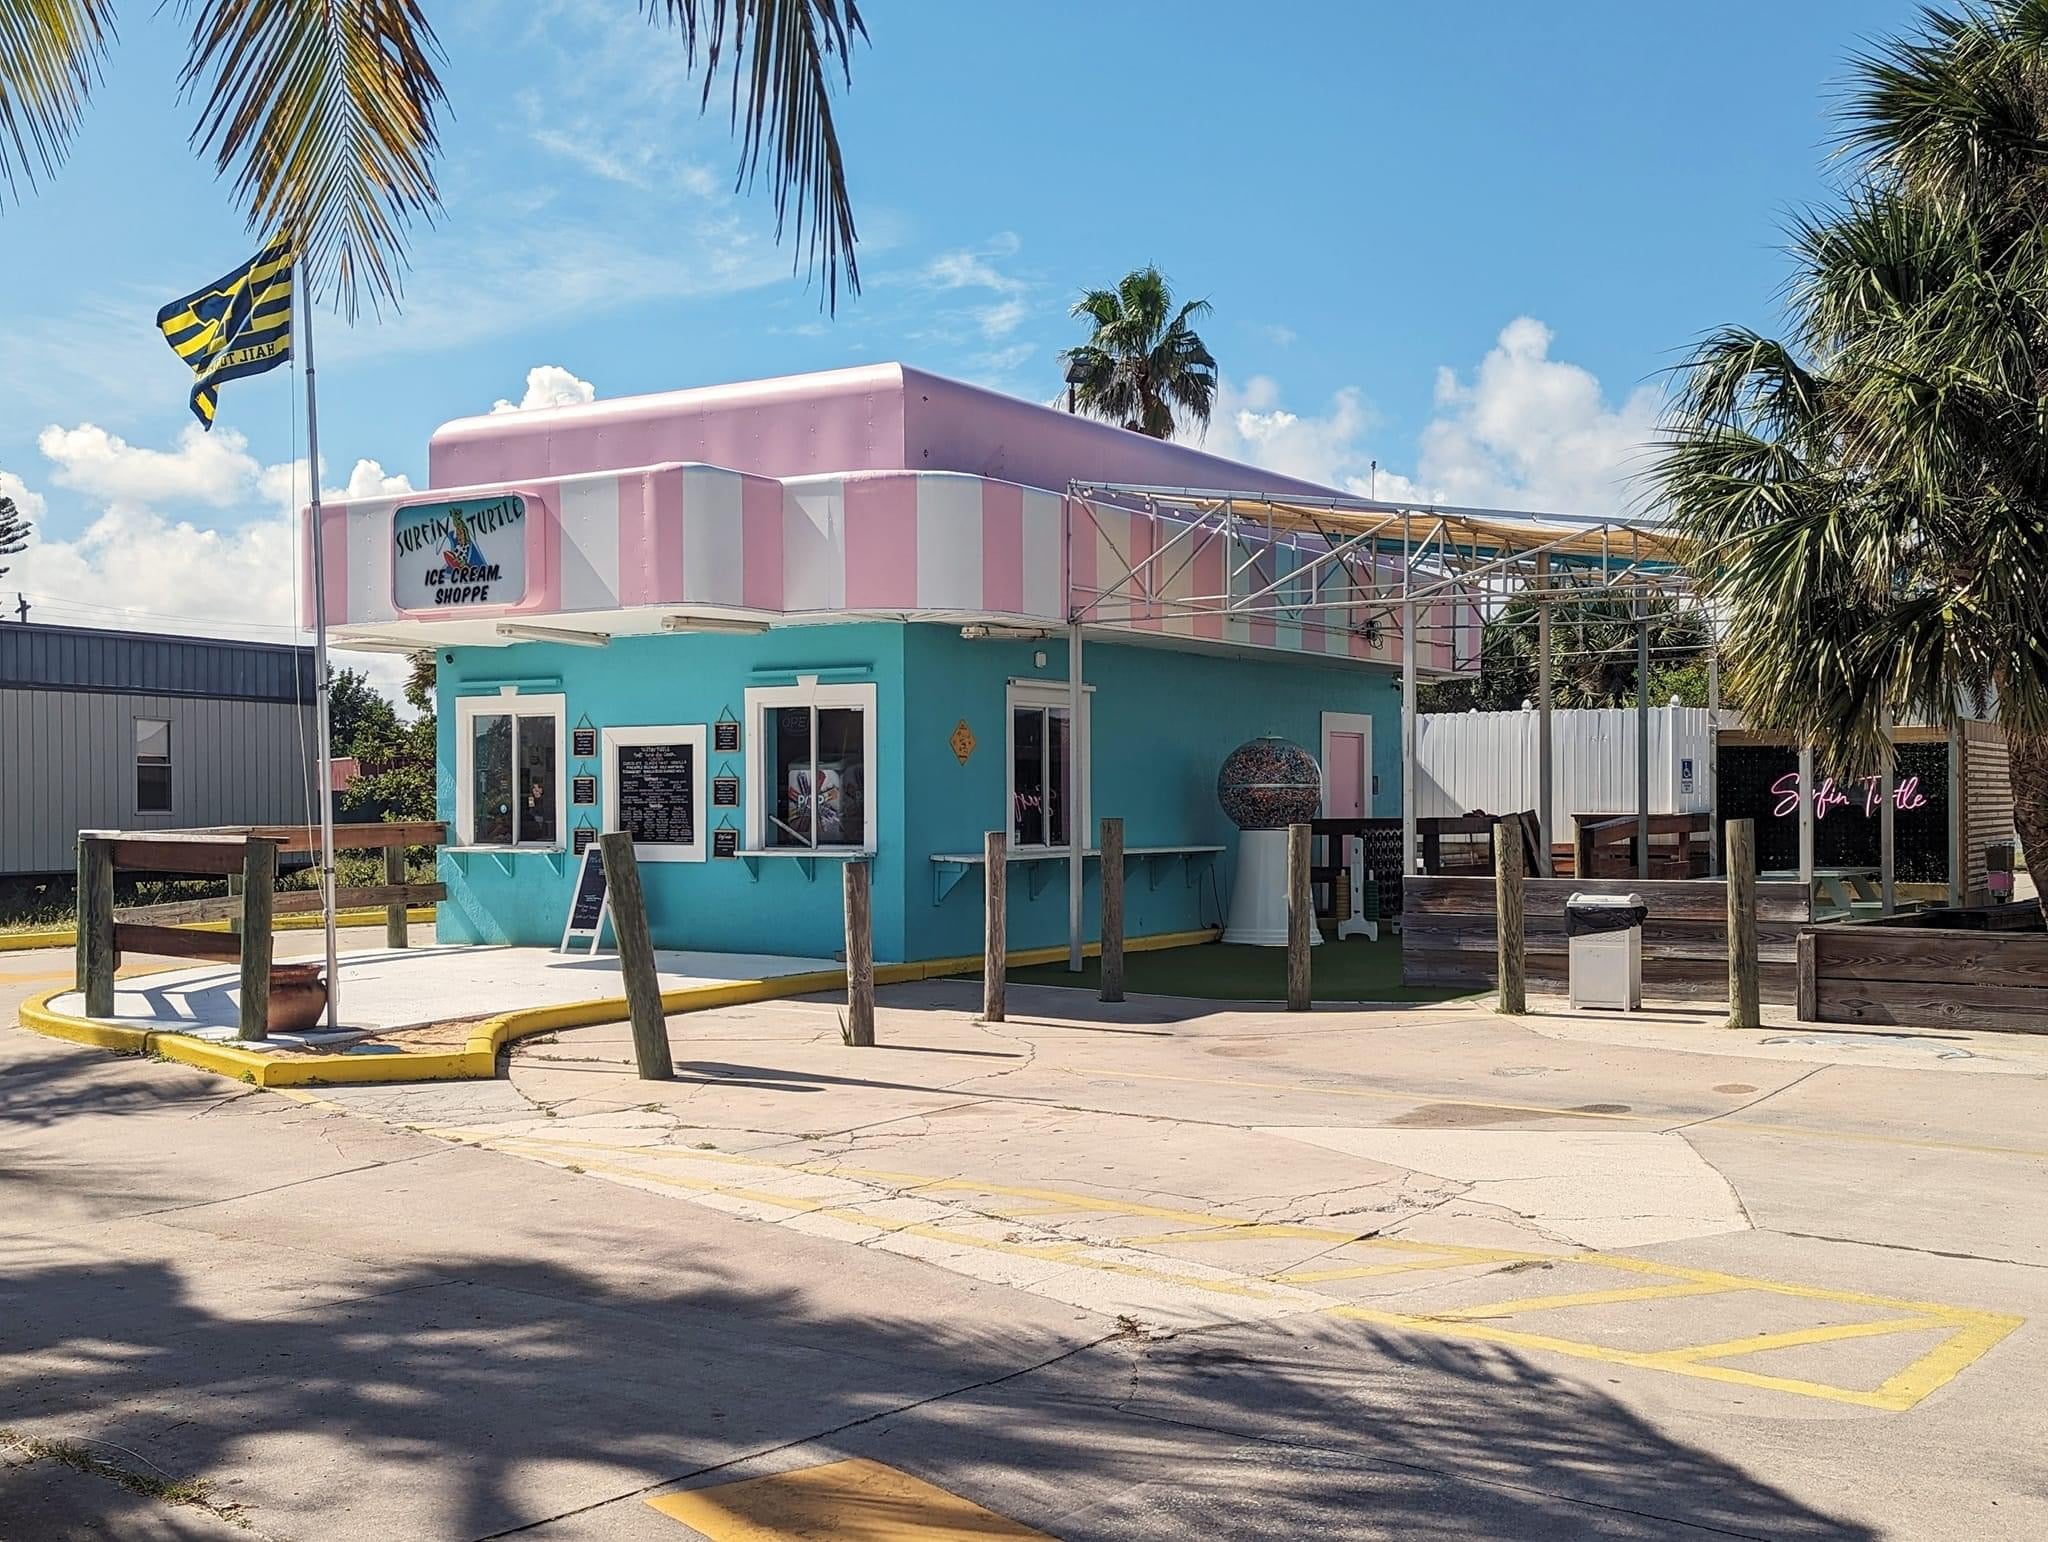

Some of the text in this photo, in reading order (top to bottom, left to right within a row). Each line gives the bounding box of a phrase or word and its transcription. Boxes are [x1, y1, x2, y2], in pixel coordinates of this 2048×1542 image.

[466, 498, 522, 537] TURTLE
[424, 569, 446, 586] ICE
[434, 585, 489, 605] SHOPPE
[782, 716, 808, 729] OPE
[1770, 773, 1927, 819] Srfin Tutle
